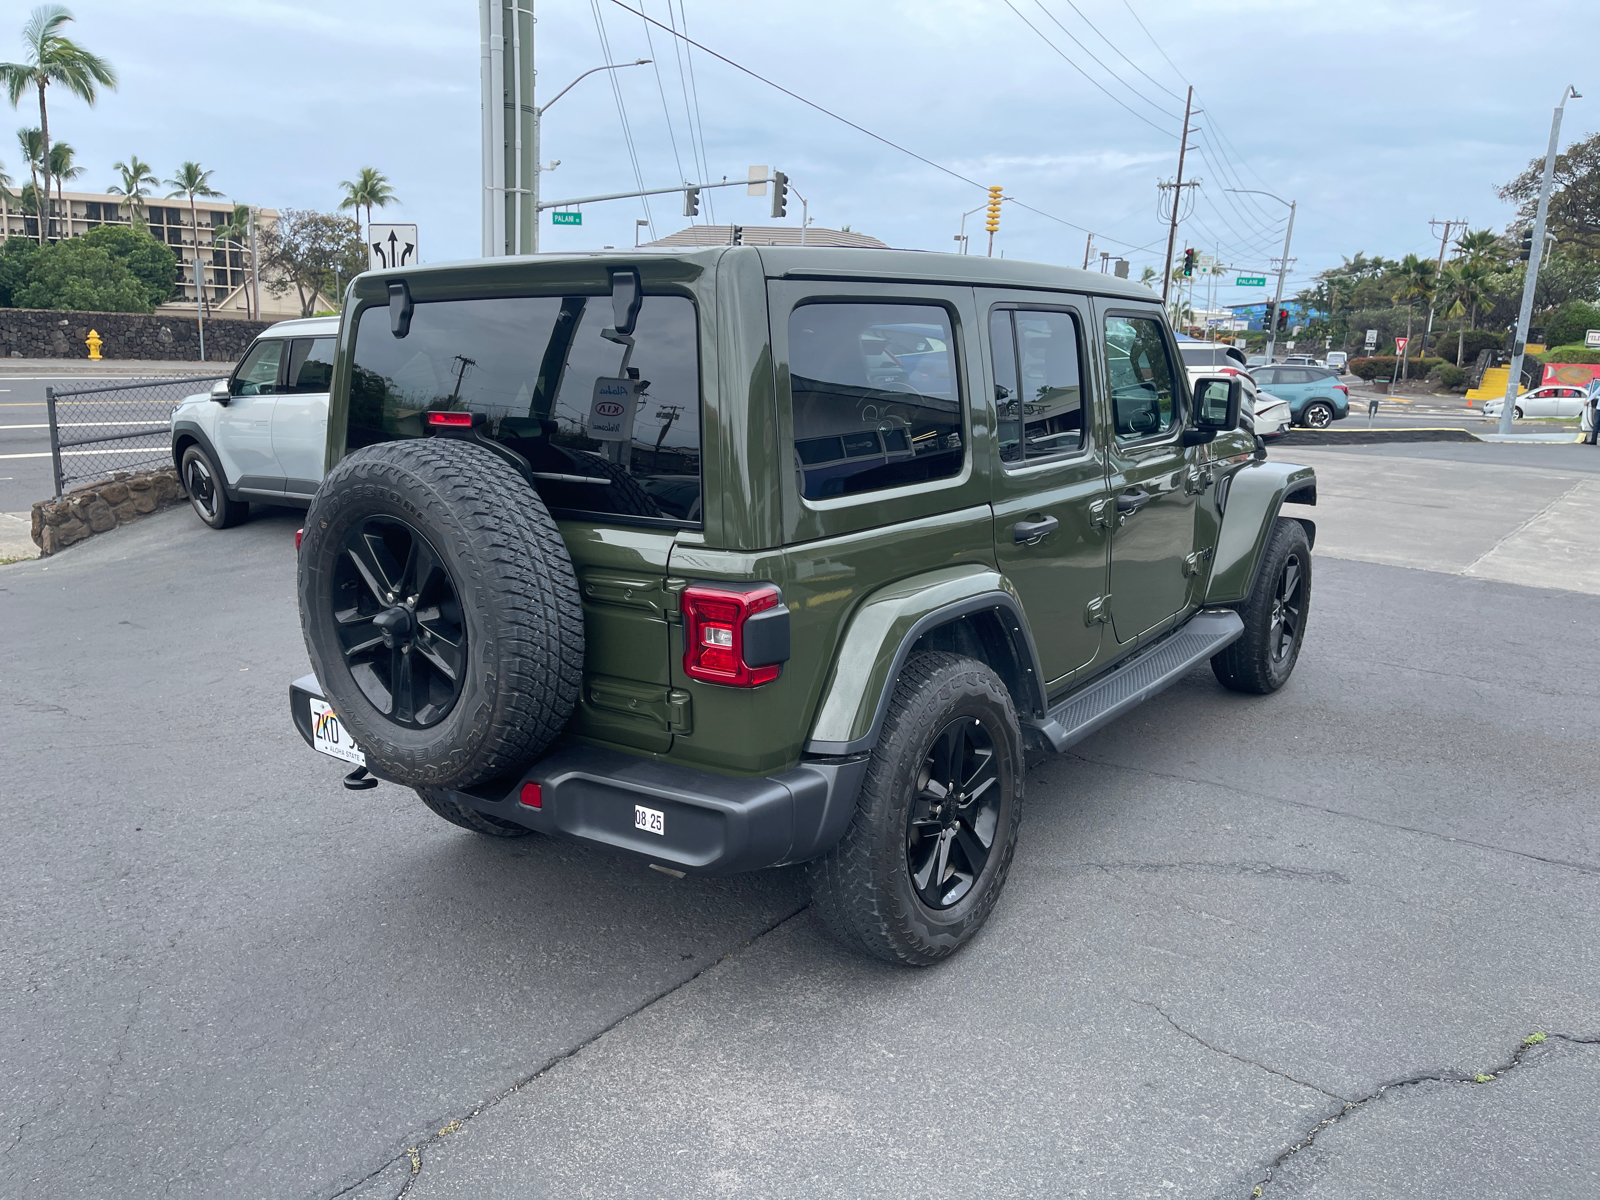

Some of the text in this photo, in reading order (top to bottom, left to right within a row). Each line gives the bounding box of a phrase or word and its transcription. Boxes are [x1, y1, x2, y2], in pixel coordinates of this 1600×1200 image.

[311, 483, 430, 553] BRIDGESTONE
[313, 711, 339, 744] ZKD
[364, 722, 460, 763] DUELER
[330, 746, 360, 761] ALOHA STATE
[635, 809, 662, 831] 08 25
